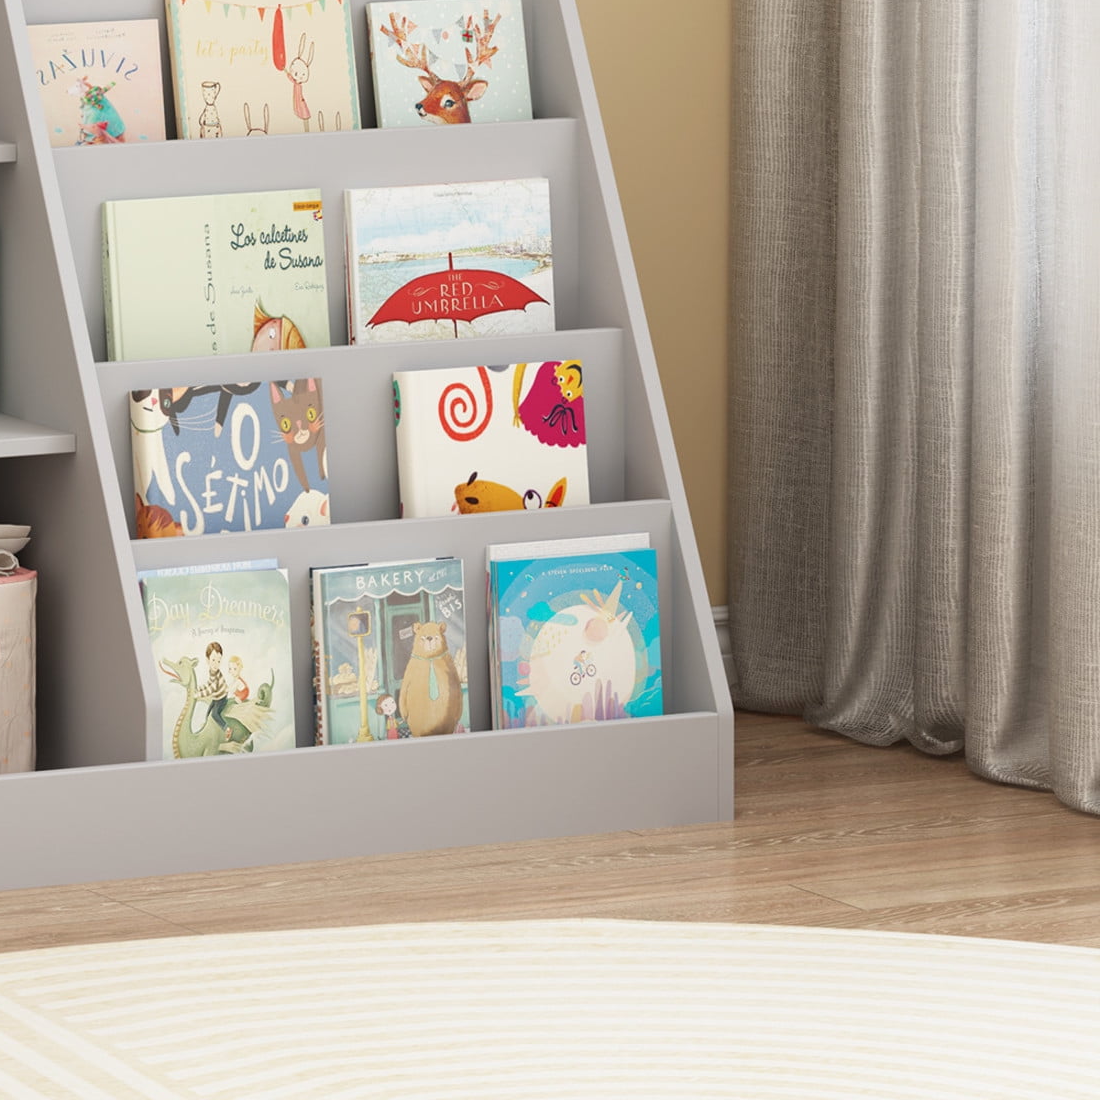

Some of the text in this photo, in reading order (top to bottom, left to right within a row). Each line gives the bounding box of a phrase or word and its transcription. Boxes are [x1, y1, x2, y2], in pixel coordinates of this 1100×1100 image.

[230, 223, 308, 250] Los calcetines
[264, 247, 323, 270] de Susana
[440, 282, 473, 297] RED
[412, 295, 504, 314] UMBRELLA
[231, 403, 260, 470] O
[356, 570, 425, 590] BAKERY
[146, 580, 284, 630] Day Dreamers
